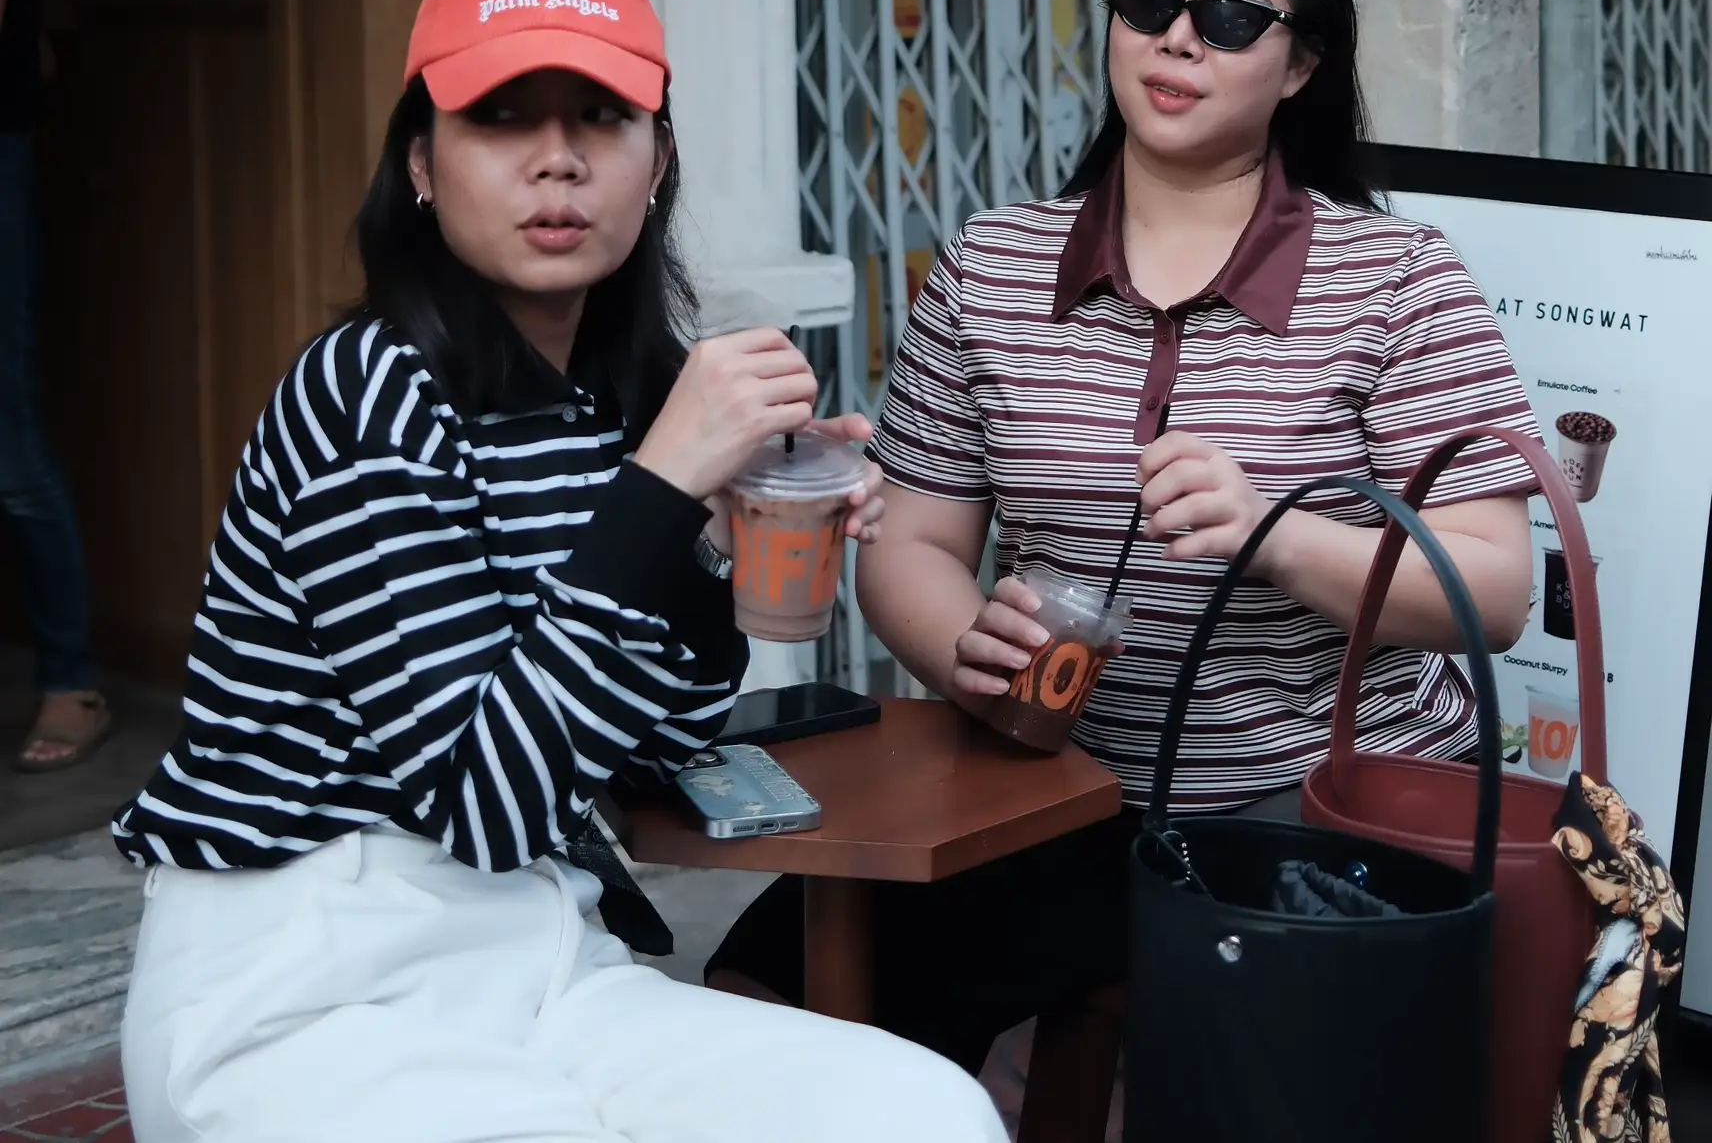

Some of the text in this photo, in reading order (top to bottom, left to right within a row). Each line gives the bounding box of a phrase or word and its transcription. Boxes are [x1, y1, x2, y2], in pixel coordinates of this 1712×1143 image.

[1496, 297, 1649, 332] AT SONGWAT
[1537, 379, 1598, 395] Emulate Coffee
[1503, 655, 1541, 669] Coconut
[1541, 662, 1568, 676] Slurpy
